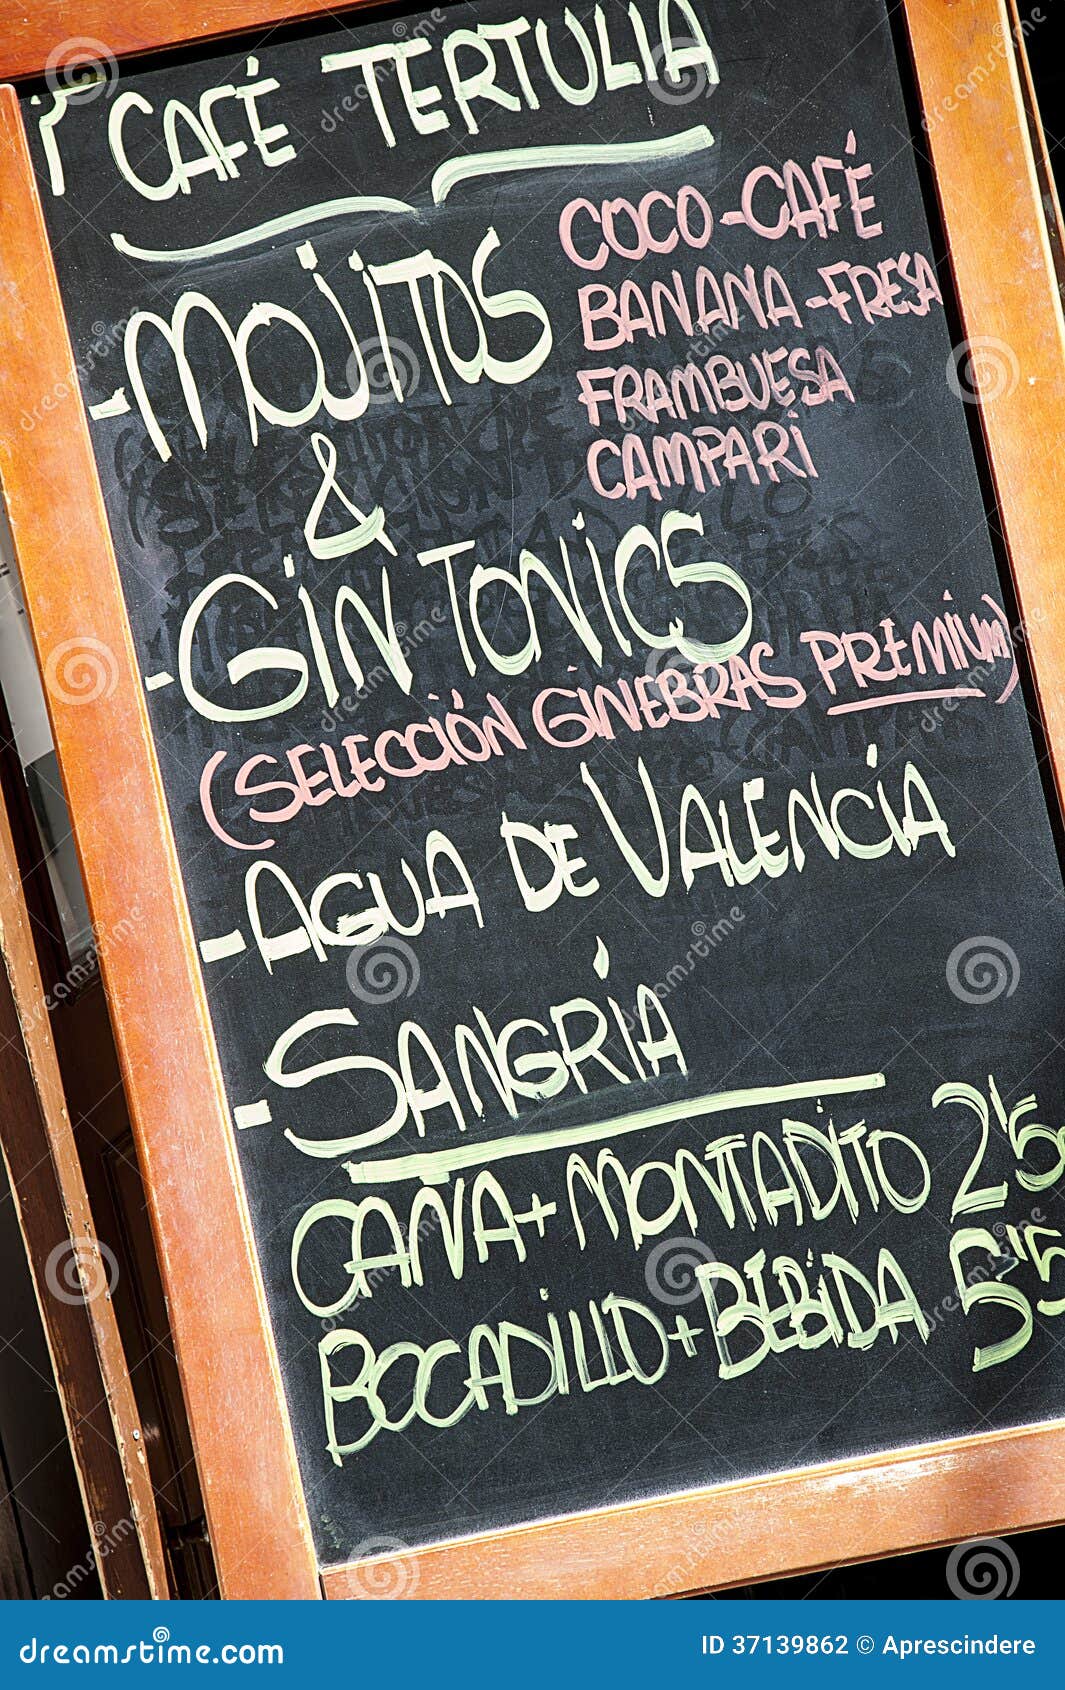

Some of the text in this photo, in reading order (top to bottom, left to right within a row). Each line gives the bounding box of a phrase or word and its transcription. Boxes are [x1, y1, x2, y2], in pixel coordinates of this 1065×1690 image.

[108, 0, 720, 200] CAFÉ TERTULIA
[577, 346, 855, 427] FRAMBUESA
[305, 433, 398, 560] &
[587, 411, 818, 500] CAMPARI
[417, 510, 752, 677] TONICS
[532, 642, 806, 748] GINEBRAS
[501, 811, 599, 912] DE
[932, 1075, 1065, 1223] 2'5
